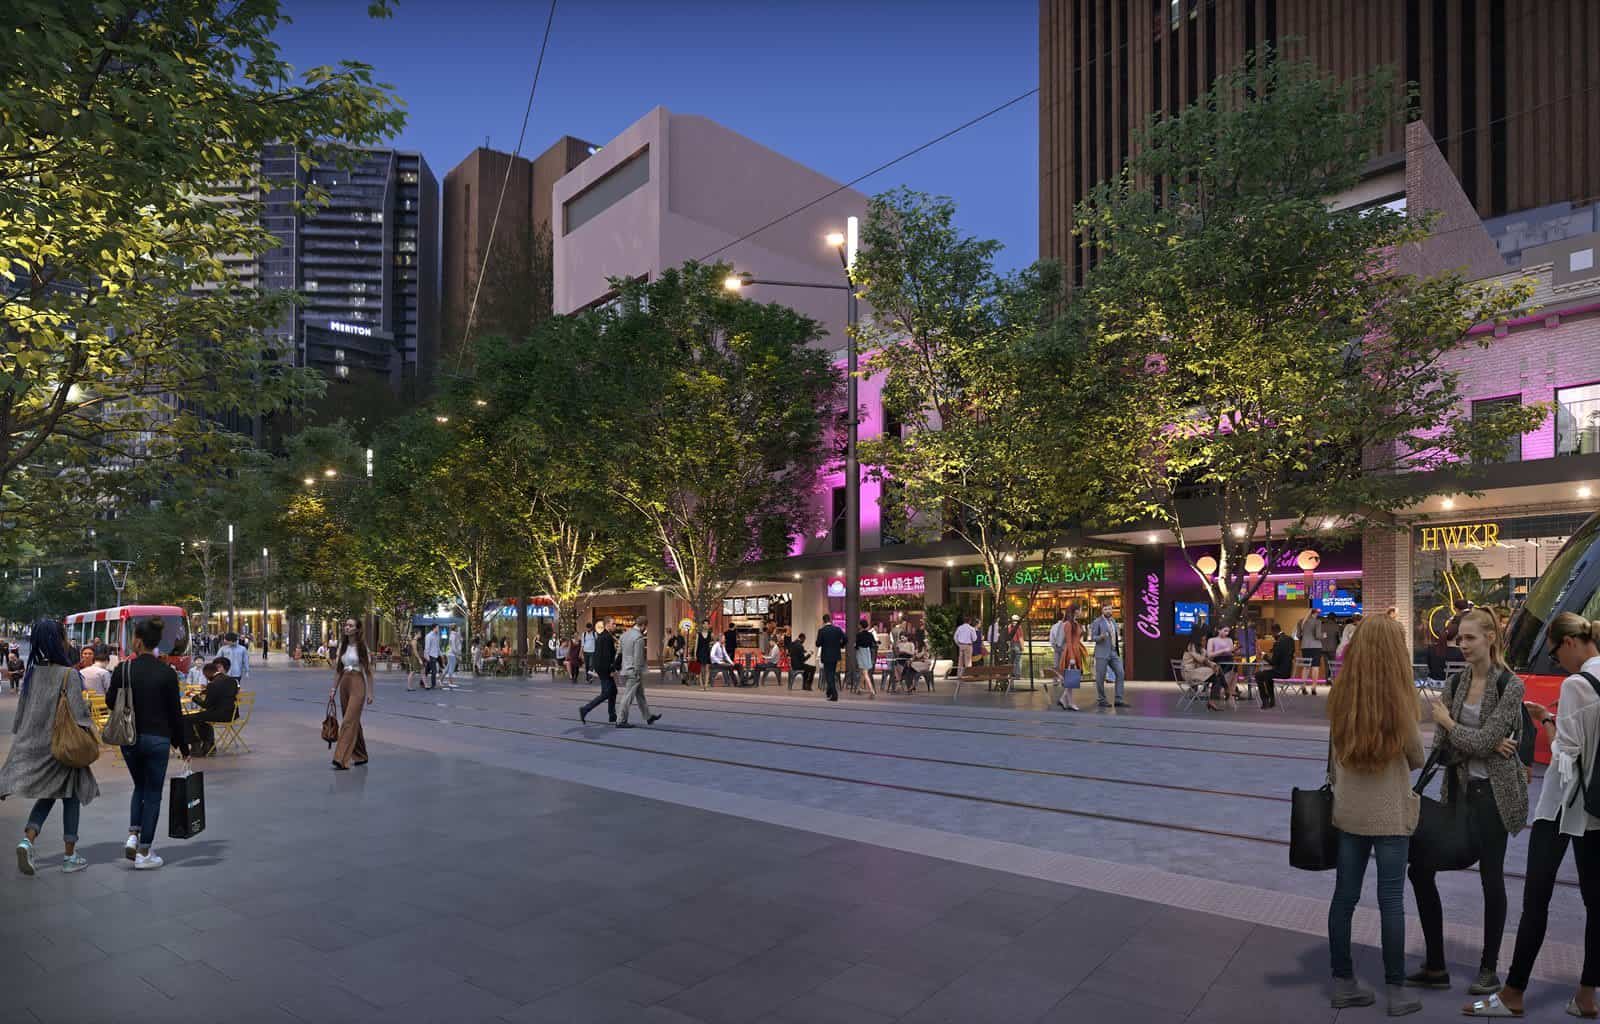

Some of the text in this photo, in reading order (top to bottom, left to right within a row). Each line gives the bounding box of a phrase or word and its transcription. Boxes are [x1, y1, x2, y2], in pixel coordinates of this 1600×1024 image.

[330, 321, 371, 336] MERITON
[1421, 523, 1499, 551] HWKR
[1137, 573, 1160, 638] Chatime
